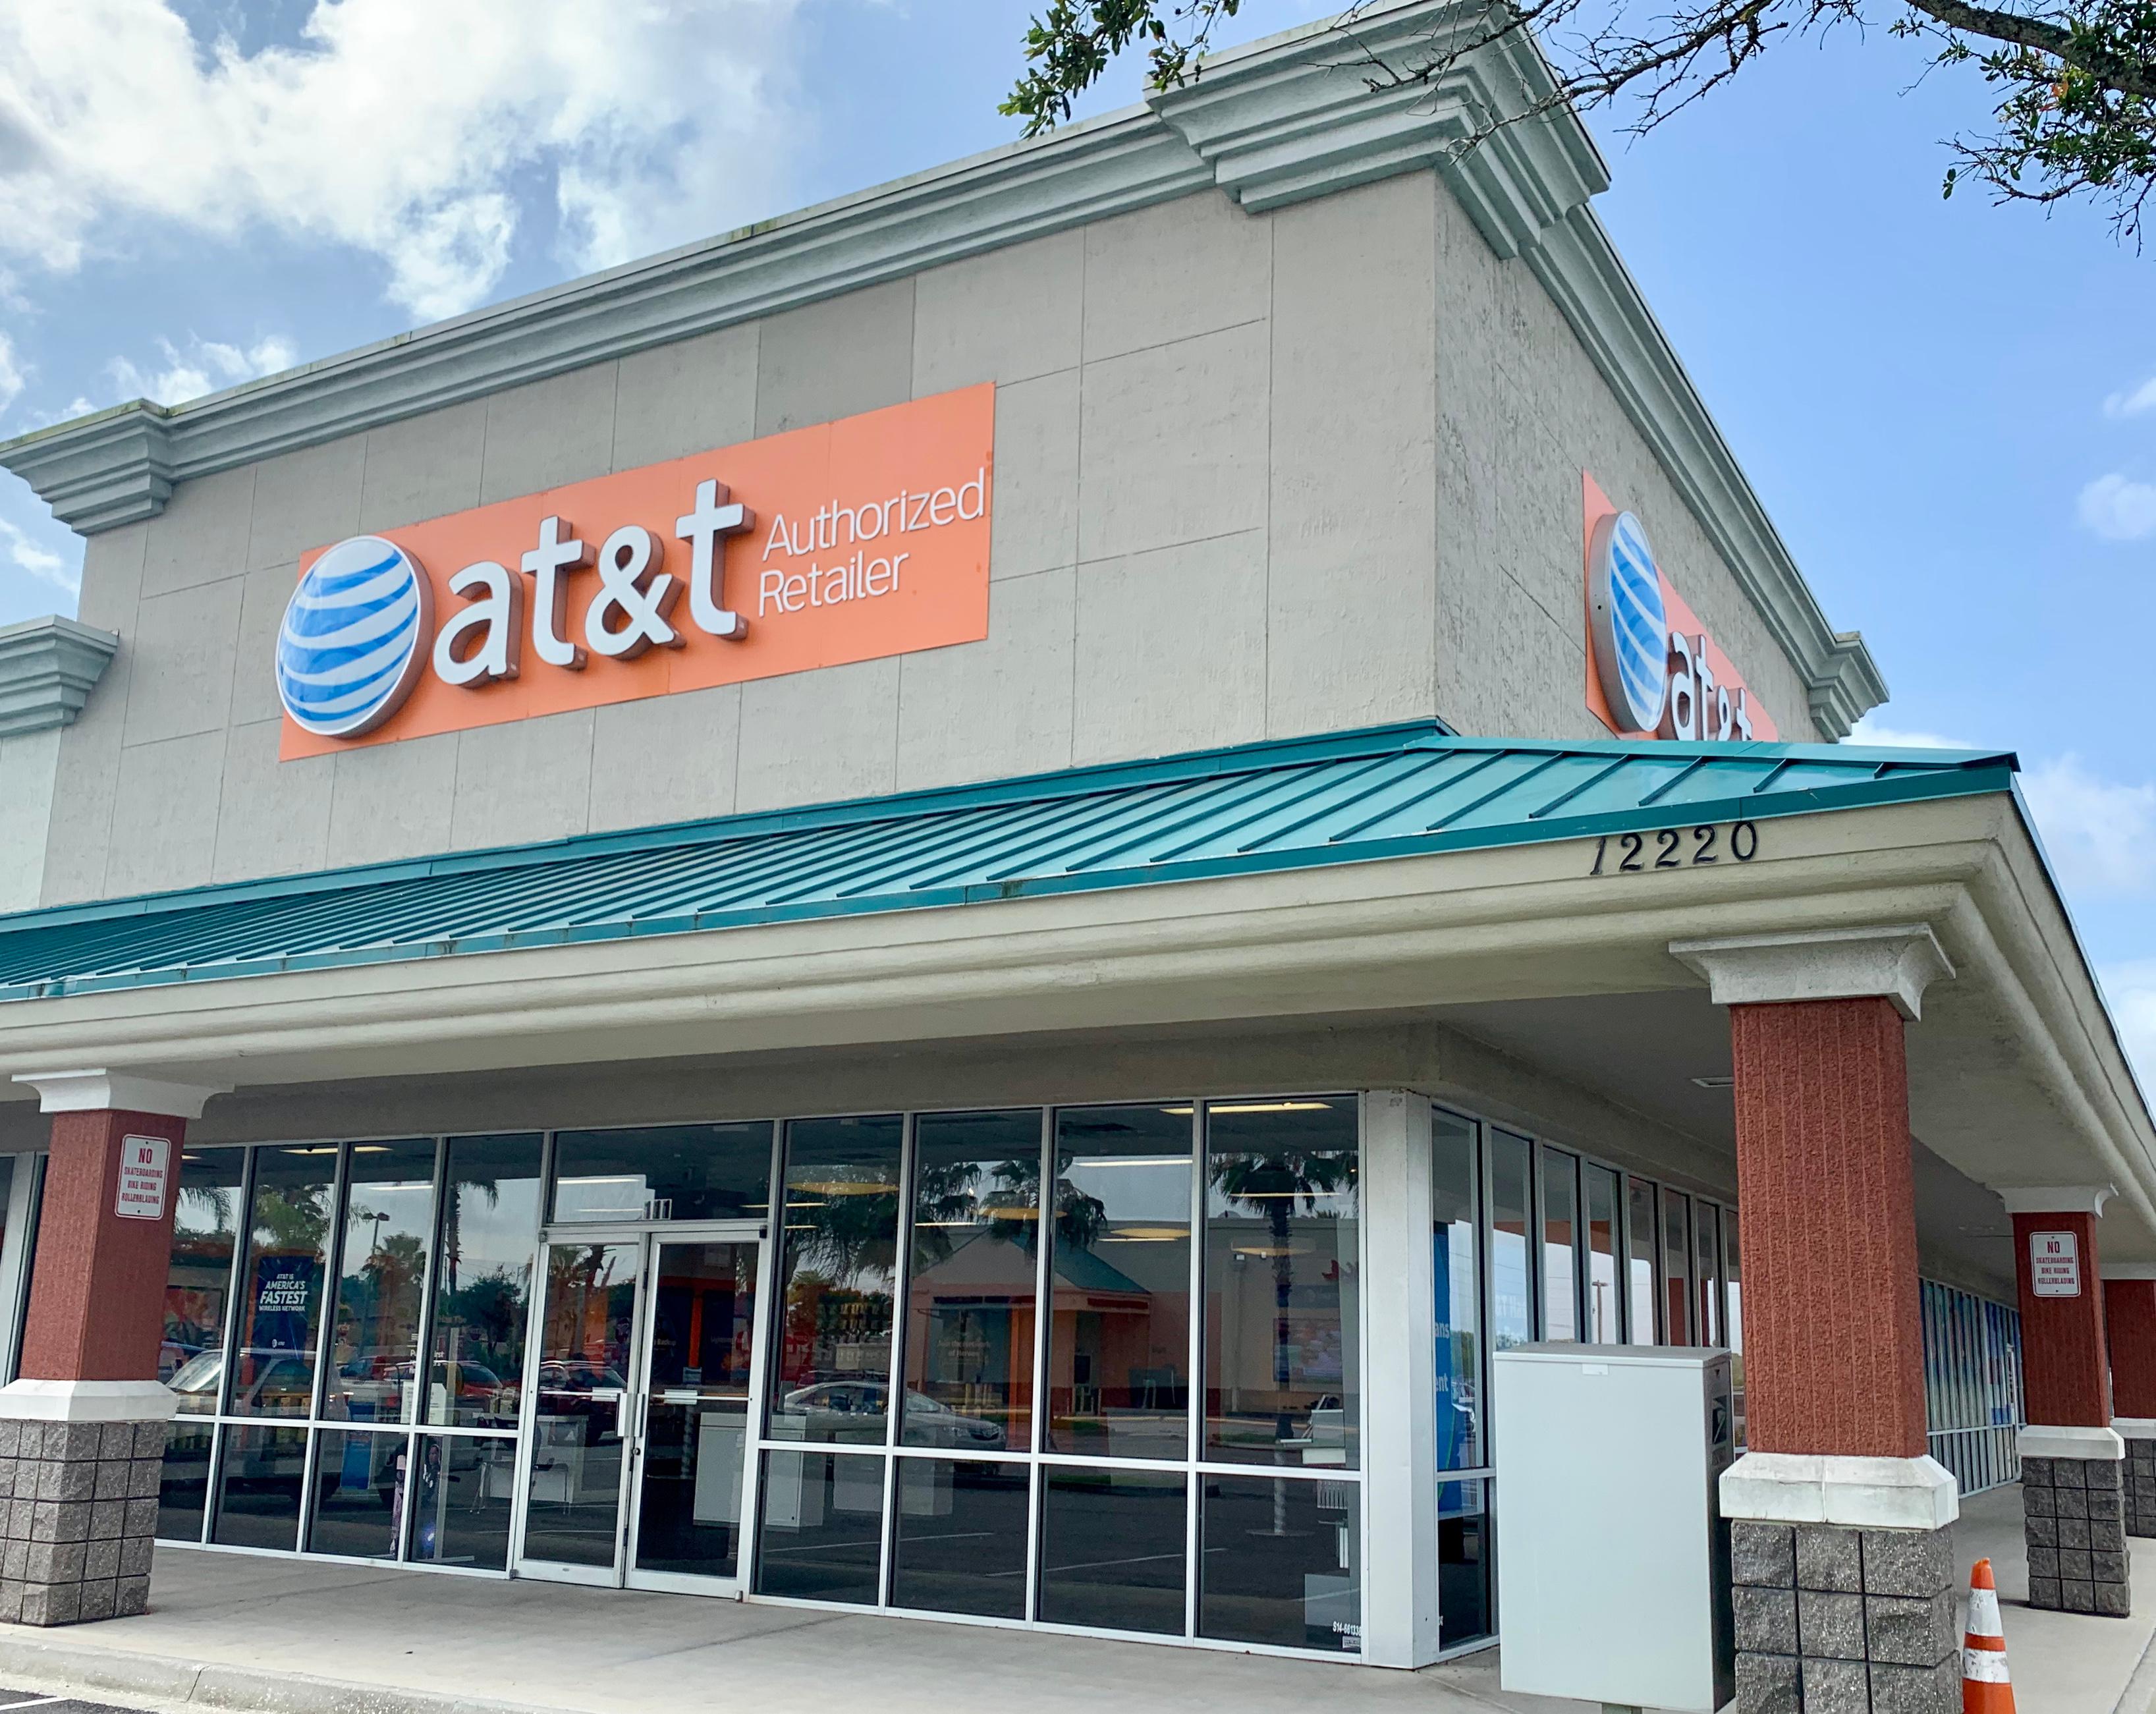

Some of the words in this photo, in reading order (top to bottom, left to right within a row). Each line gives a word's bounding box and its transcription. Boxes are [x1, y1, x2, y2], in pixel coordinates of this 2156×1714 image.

[762, 467, 985, 561] Authorized
[433, 478, 751, 687] at&t
[759, 551, 909, 617] Retailer
[1590, 821, 1757, 875] 12220
[138, 1148, 153, 1164] NO
[124, 1167, 163, 1178] SKATEBOARDING
[127, 1180, 138, 1189] BIKE
[140, 1181, 157, 1190] RIDING
[121, 1192, 160, 1204] ROLLERBLADING
[2047, 1241, 2060, 1253] NO
[265, 1281, 306, 1290] AMERICA'S
[261, 1291, 308, 1304] FASTEST
